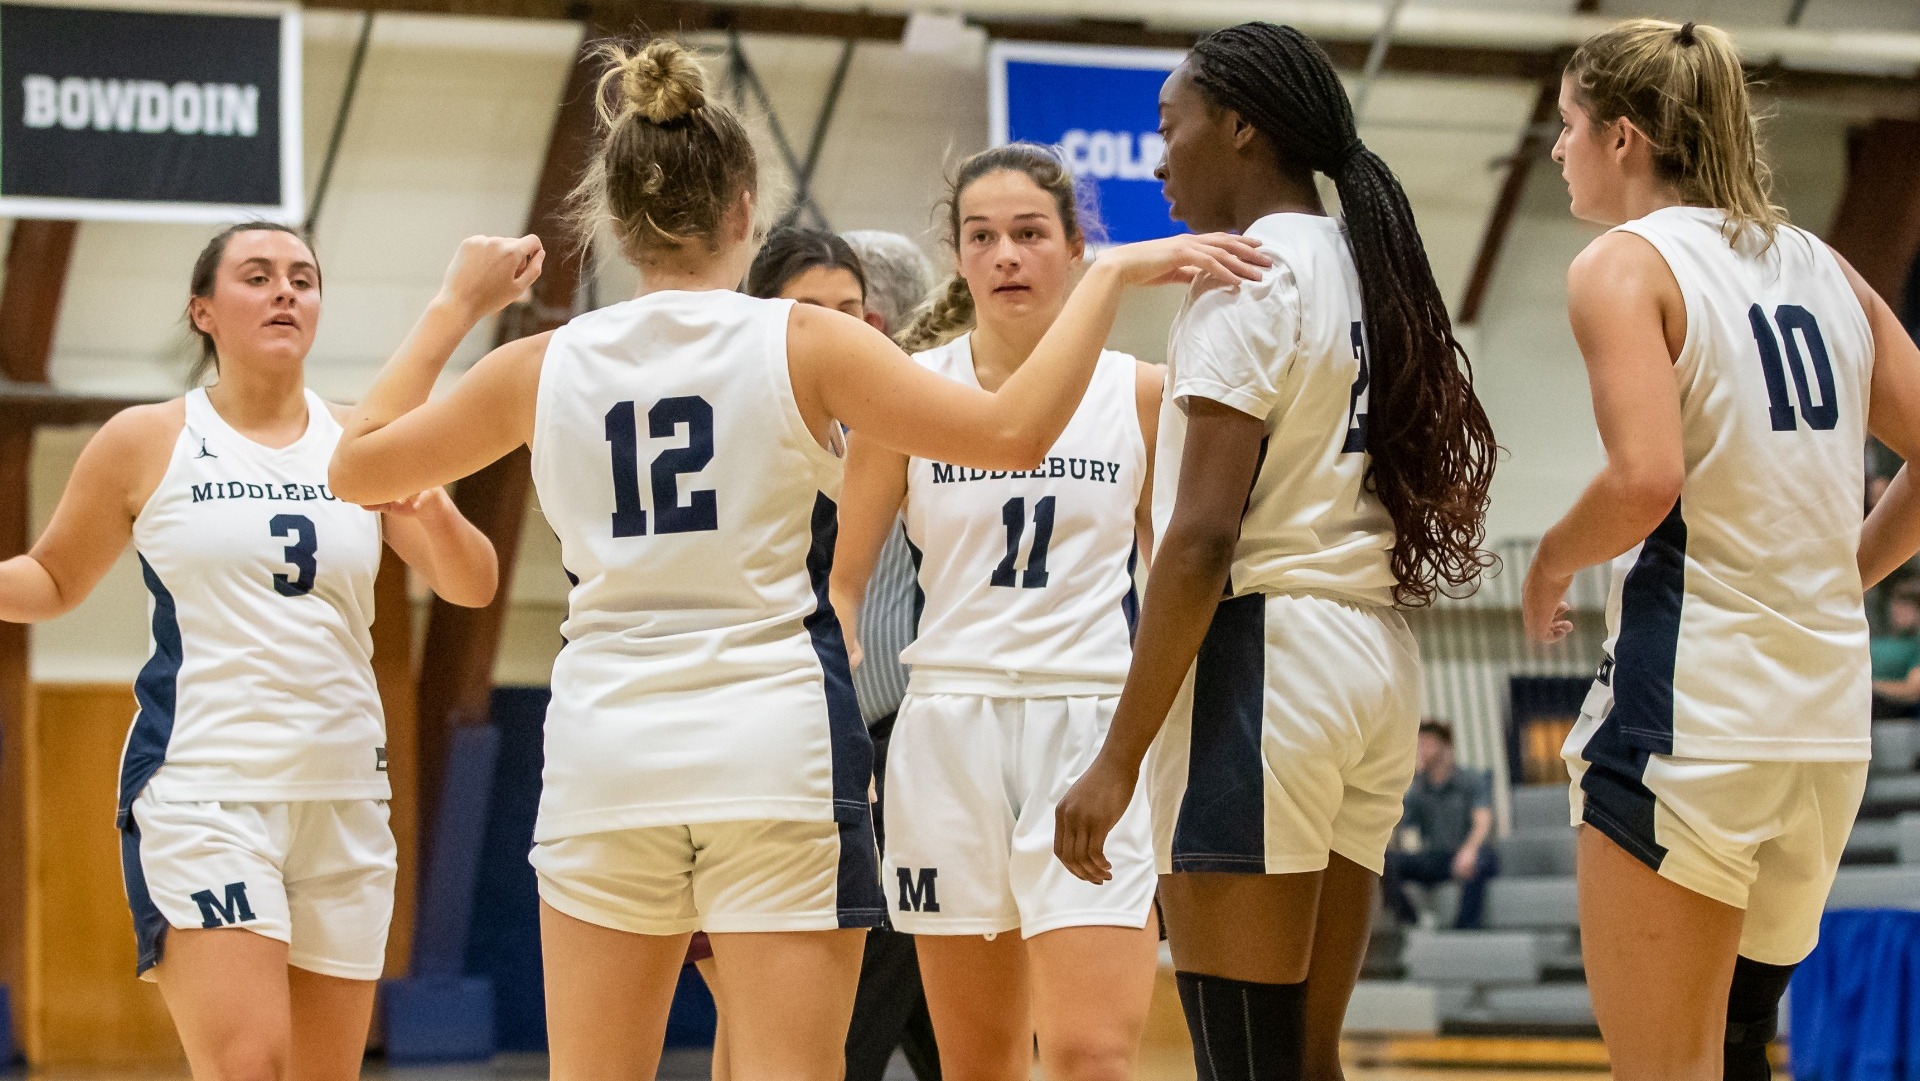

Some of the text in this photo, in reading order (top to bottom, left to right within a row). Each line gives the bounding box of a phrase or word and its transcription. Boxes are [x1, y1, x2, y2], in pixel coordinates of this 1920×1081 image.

[22, 75, 260, 138] BOWDOIN
[1748, 303, 1838, 431] 10
[191, 481, 337, 503] MIDDLEBU
[604, 395, 718, 538] 12
[269, 514, 317, 597] 3
[990, 495, 1056, 588] 11
[190, 881, 256, 929] M
[897, 867, 940, 912] M
